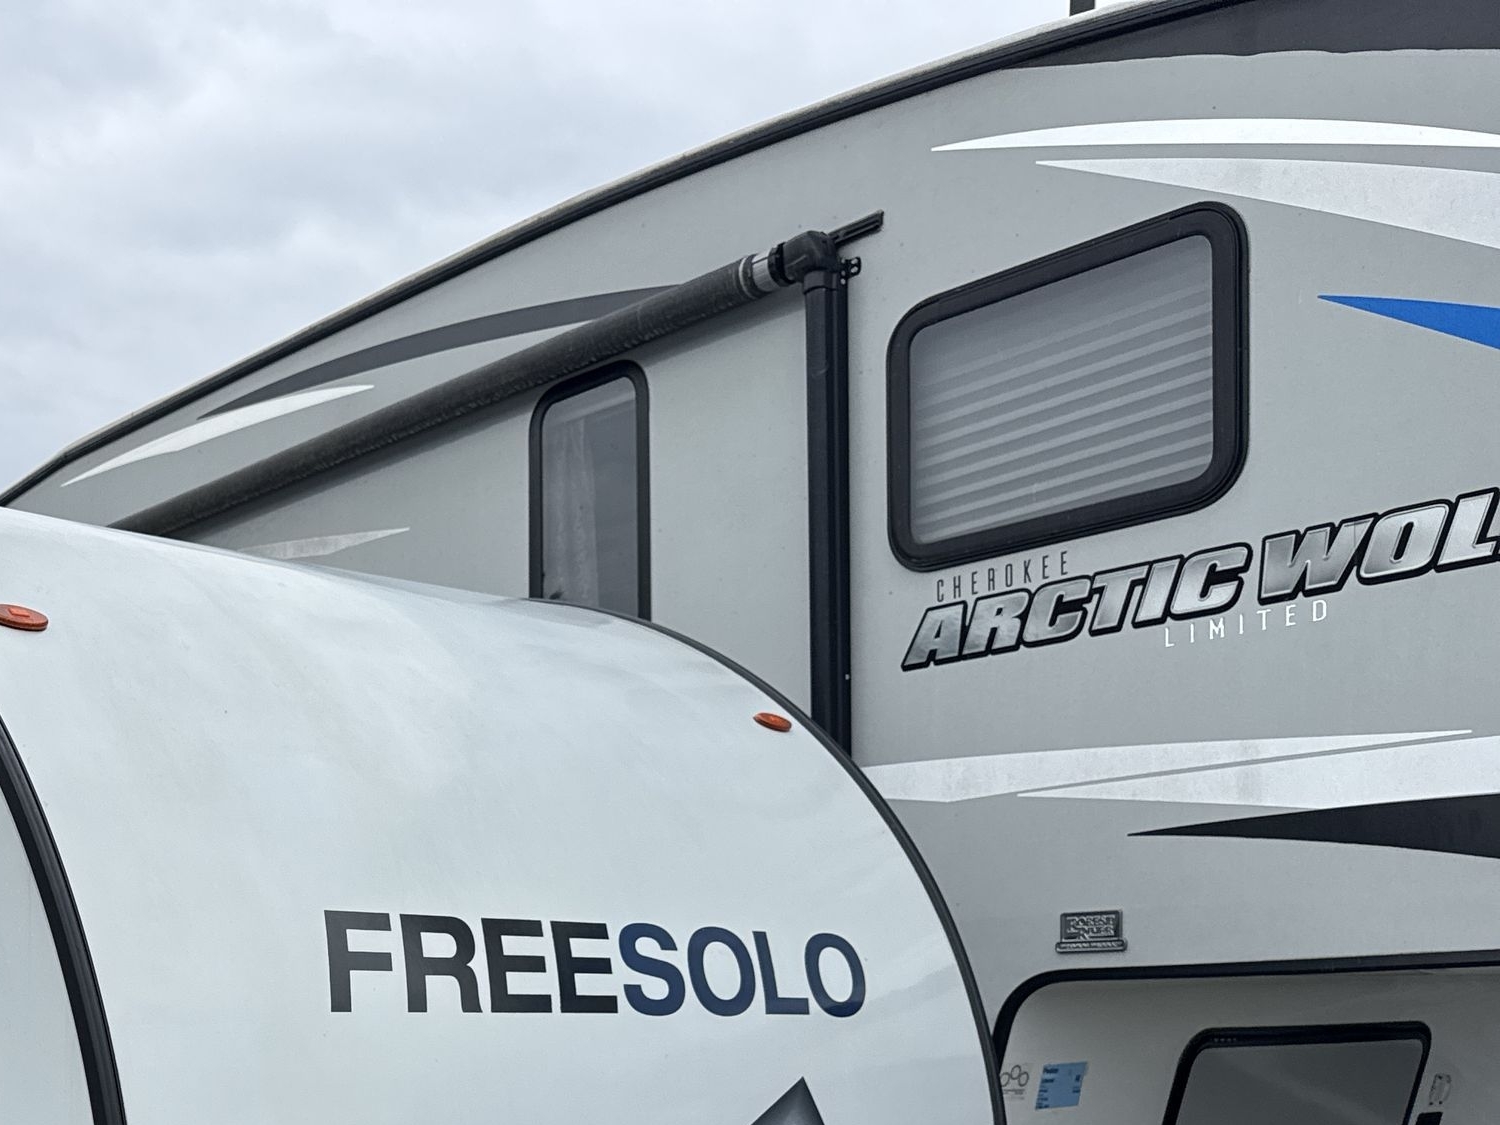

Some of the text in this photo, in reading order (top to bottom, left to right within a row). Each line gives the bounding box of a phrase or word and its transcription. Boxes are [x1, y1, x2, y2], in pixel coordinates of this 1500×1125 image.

[901, 487, 1500, 671] ARCTIC WOL
[936, 550, 1070, 603] CHEROKEE
[1163, 599, 1329, 648] LIMITED
[323, 909, 867, 1018] FREESOLO
